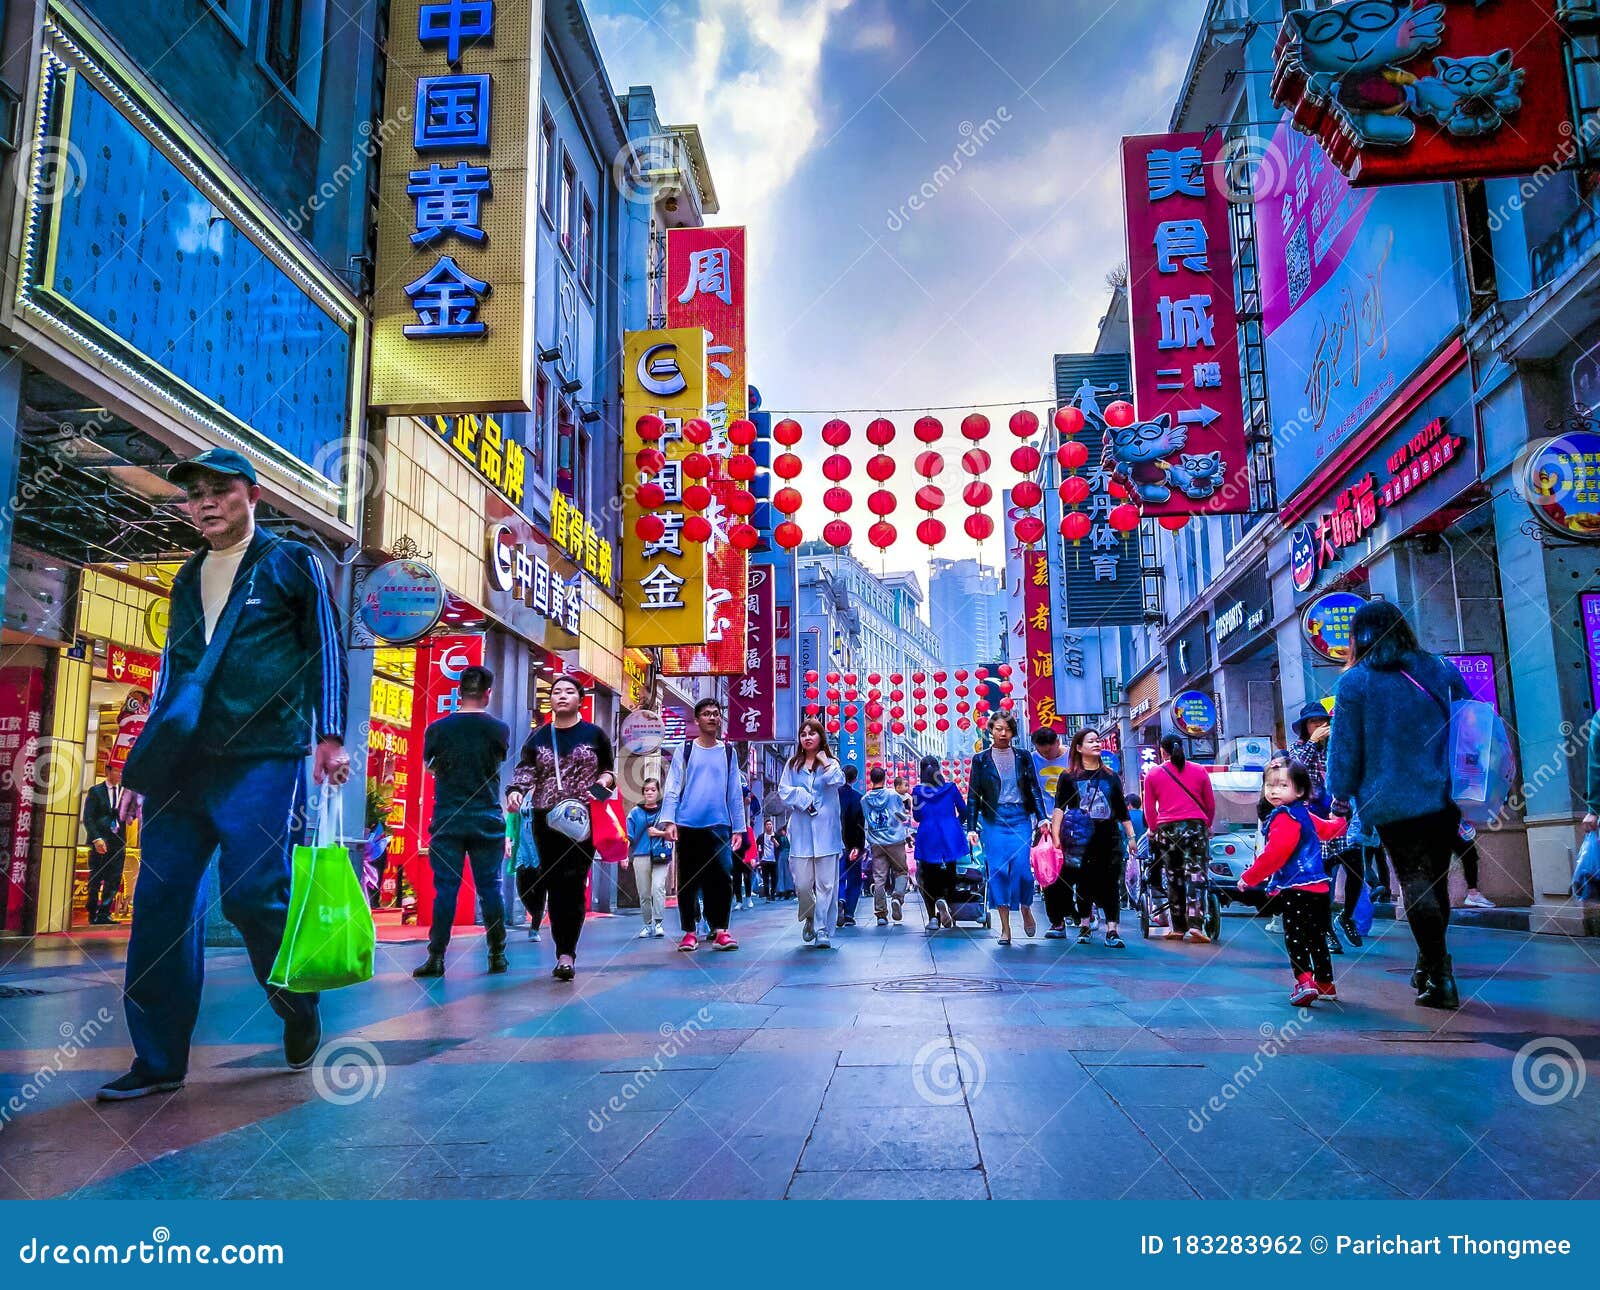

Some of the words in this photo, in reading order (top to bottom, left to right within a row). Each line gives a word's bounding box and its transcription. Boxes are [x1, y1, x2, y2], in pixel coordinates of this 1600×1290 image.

[402, 0, 494, 340] 中国黄金
[1146, 146, 1216, 350] 美食城
[434, 414, 525, 504] 企品牌
[1386, 445, 1408, 474] NEW
[1408, 417, 1442, 457] YOUTH
[550, 487, 613, 589] 值得信赖
[639, 410, 685, 609] 中国黄金
[1087, 465, 1120, 582] 乔丹体育
[515, 543, 582, 637] 中国黄金
[11, 711, 41, 884] 黄金免费换新款
